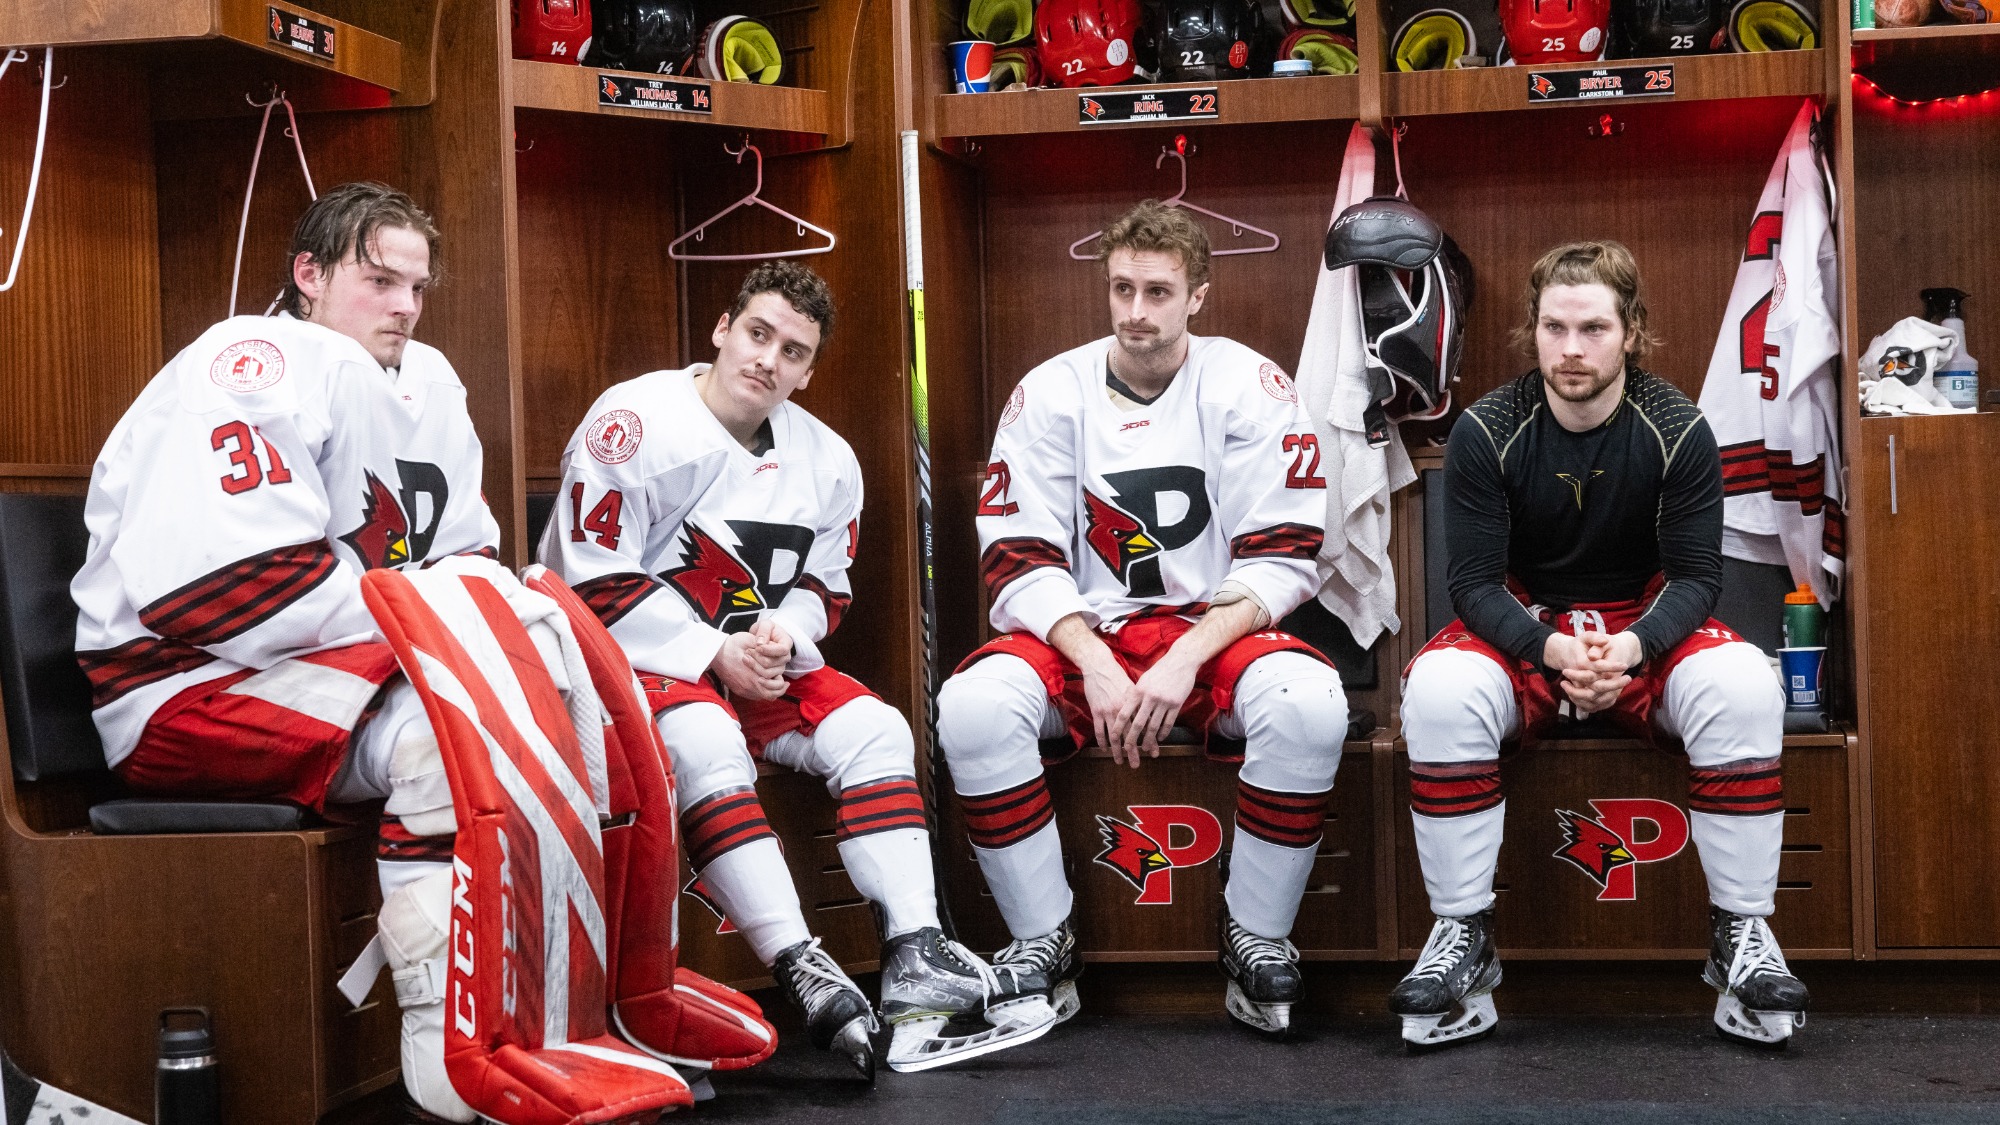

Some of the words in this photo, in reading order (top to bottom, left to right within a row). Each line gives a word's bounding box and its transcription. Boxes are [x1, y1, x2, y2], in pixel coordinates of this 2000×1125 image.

[551, 41, 567, 56] 14
[1542, 37, 1566, 52] 25
[1670, 35, 1694, 49] 25
[1180, 50, 1205, 66] 22
[656, 60, 673, 75] 14
[1062, 58, 1086, 76] 22
[648, 80, 663, 89] TREY
[1579, 76, 1622, 90] BRYER
[1644, 69, 1672, 90] 25
[634, 86, 678, 102] THOMAS
[692, 89, 709, 108] 14
[630, 98, 658, 108] WILLIAMS
[675, 103, 683, 111] BC
[1133, 100, 1164, 113] RING
[1189, 94, 1216, 114] 22
[1955, 380, 1962, 390] 5
[210, 419, 293, 496] 31
[1281, 433, 1327, 489] 22
[570, 481, 624, 552] 14
[925, 521, 933, 557] ALPHA
[453, 853, 476, 1040] CCM
[890, 978, 968, 1010] VAPOR
